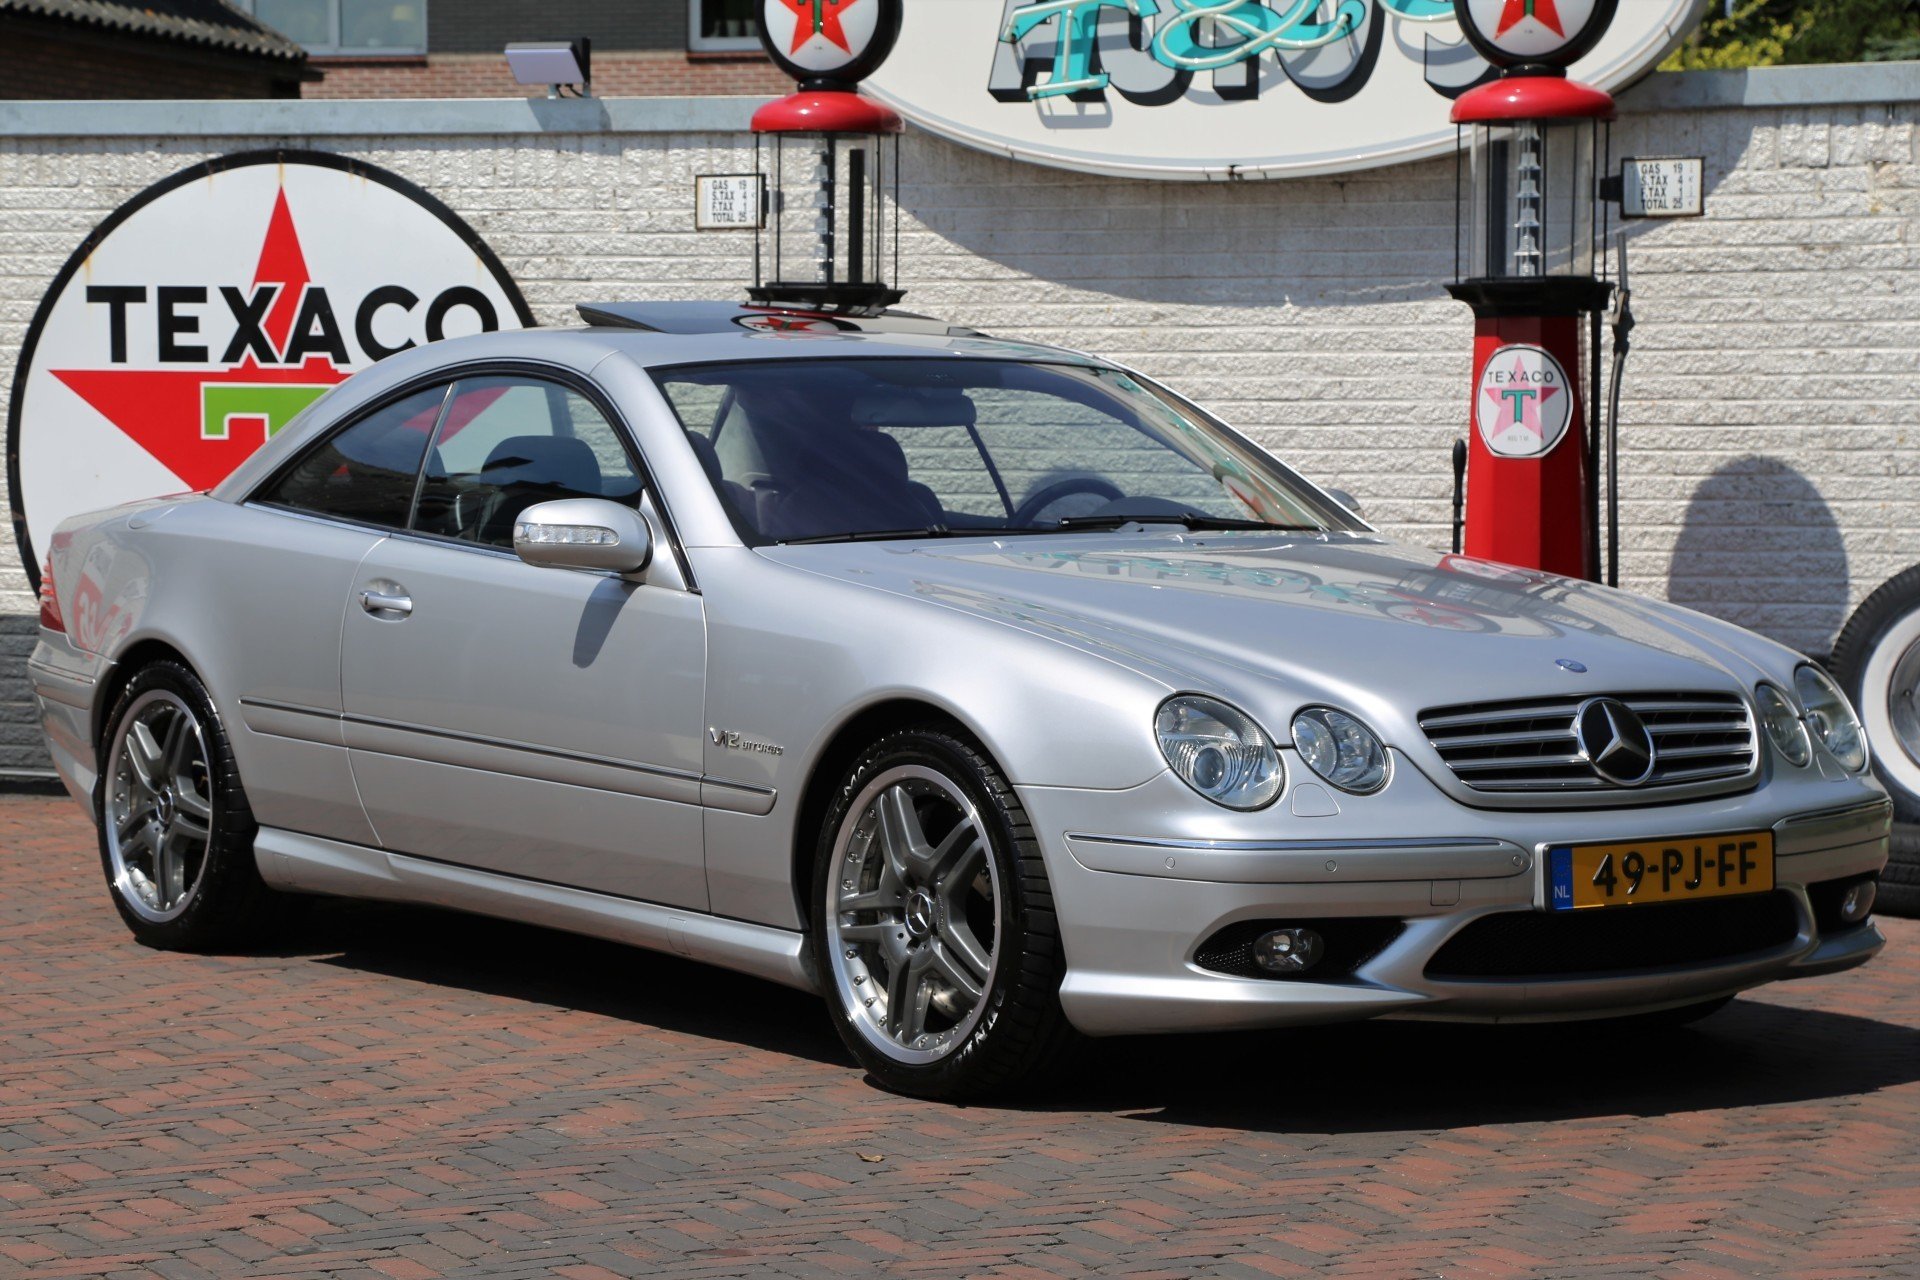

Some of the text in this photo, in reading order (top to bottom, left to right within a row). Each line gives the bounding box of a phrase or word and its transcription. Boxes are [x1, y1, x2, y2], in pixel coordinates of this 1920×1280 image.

[1641, 163, 1683, 174] GAS 19
[712, 180, 729, 190] GAS
[1641, 175, 1683, 186] S.TAX 4
[1641, 198, 1683, 210] TOTAL 25
[712, 212, 747, 222] TOTAL 25
[86, 285, 499, 364] TEXACO
[1488, 370, 1554, 384] TEXACO
[709, 727, 740, 749] V12
[1592, 841, 1757, 897] 49-PJ-FF
[1554, 885, 1570, 898] NL
